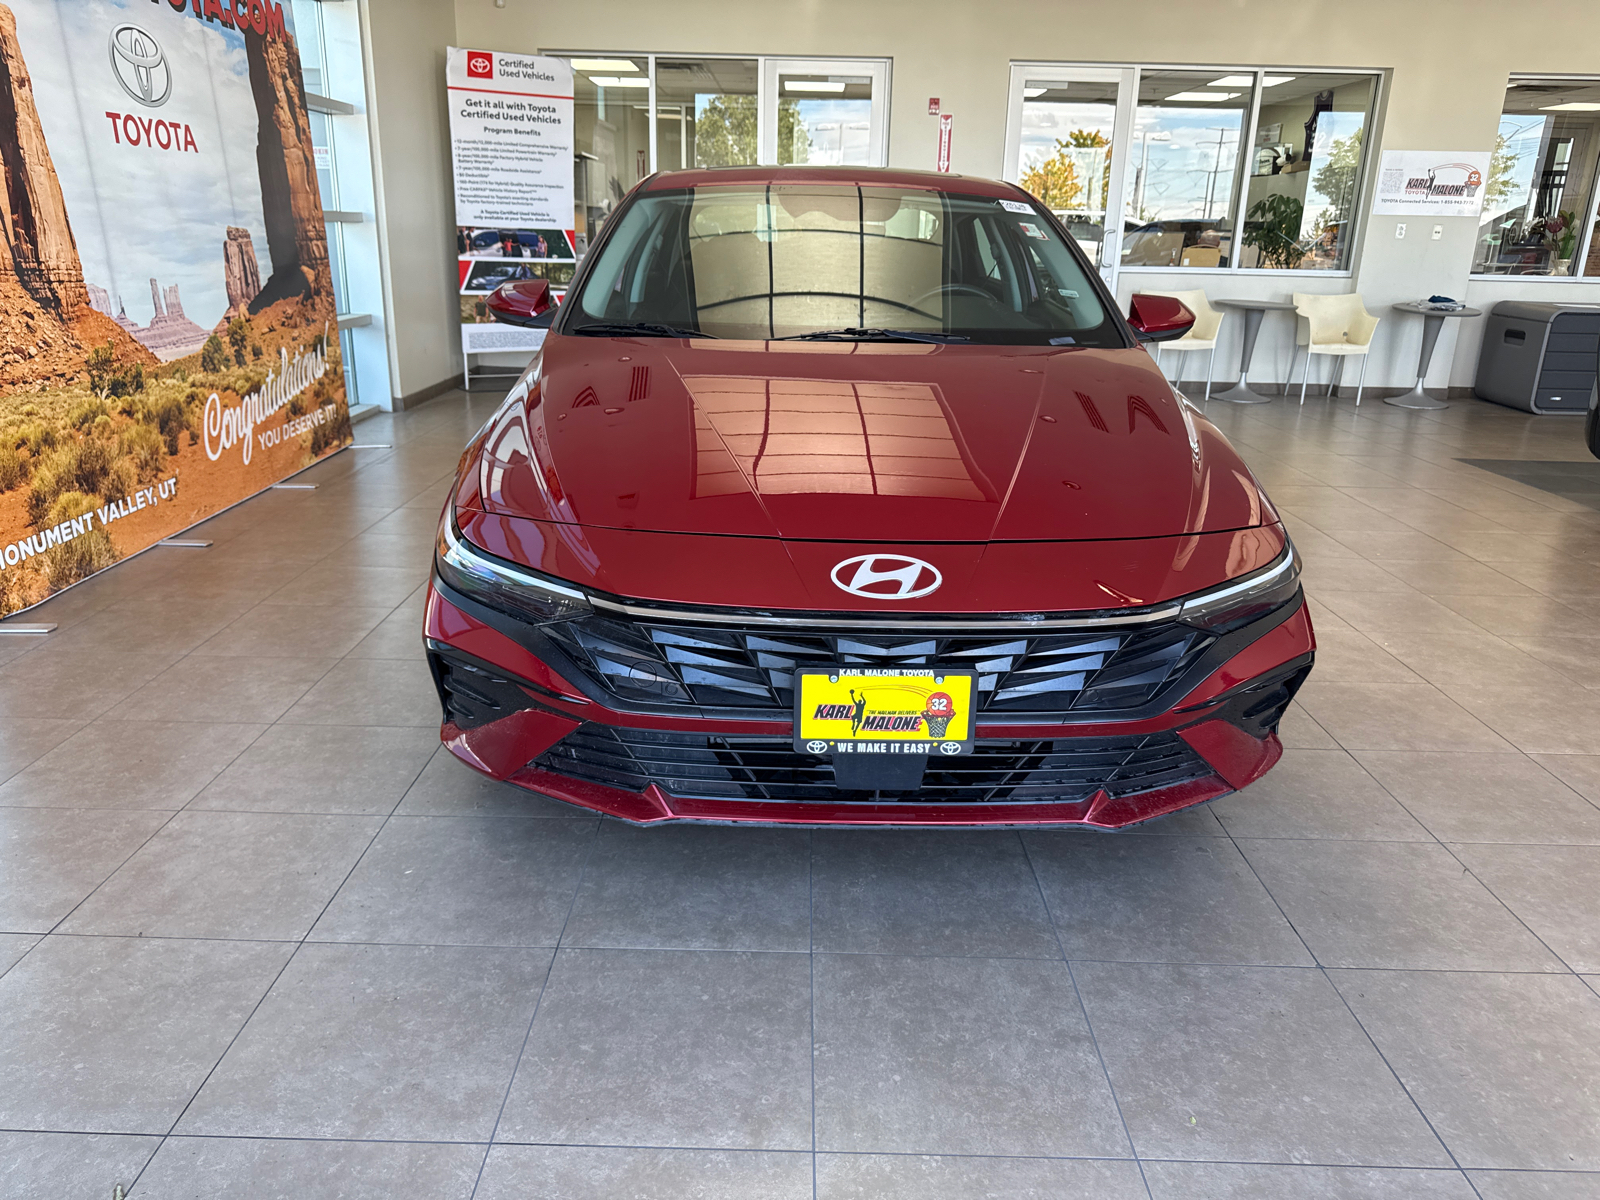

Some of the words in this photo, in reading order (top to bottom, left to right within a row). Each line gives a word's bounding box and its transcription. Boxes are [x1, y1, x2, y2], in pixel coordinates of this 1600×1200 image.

[499, 59, 534, 69] Certified
[499, 69, 520, 78] Used
[522, 71, 555, 81] Vehicles
[466, 99, 482, 108] Get
[484, 100, 491, 108] it
[493, 101, 504, 110] all
[506, 102, 526, 111] with
[528, 104, 556, 114] Toyota
[460, 110, 500, 120] Certified
[502, 113, 524, 122] Used
[526, 114, 562, 124] Vehicles
[105, 111, 199, 153] TOYOTA
[484, 126, 513, 135] Program
[1405, 178, 1430, 190] KARL
[1430, 185, 1465, 196] MALONE
[203, 320, 330, 465] Congratulations!
[258, 430, 280, 450] YOU
[283, 411, 326, 442] DESERVE
[326, 403, 337, 422] IT!
[97, 486, 158, 526] VALLEY,
[158, 477, 177, 500] UT
[931, 698, 947, 711] 32
[813, 704, 856, 720] KARL
[861, 715, 923, 732] MALONE
[837, 742, 853, 752] WE
[857, 742, 886, 752] MAKE
[891, 743, 899, 753] IT
[904, 743, 930, 753] EASY
